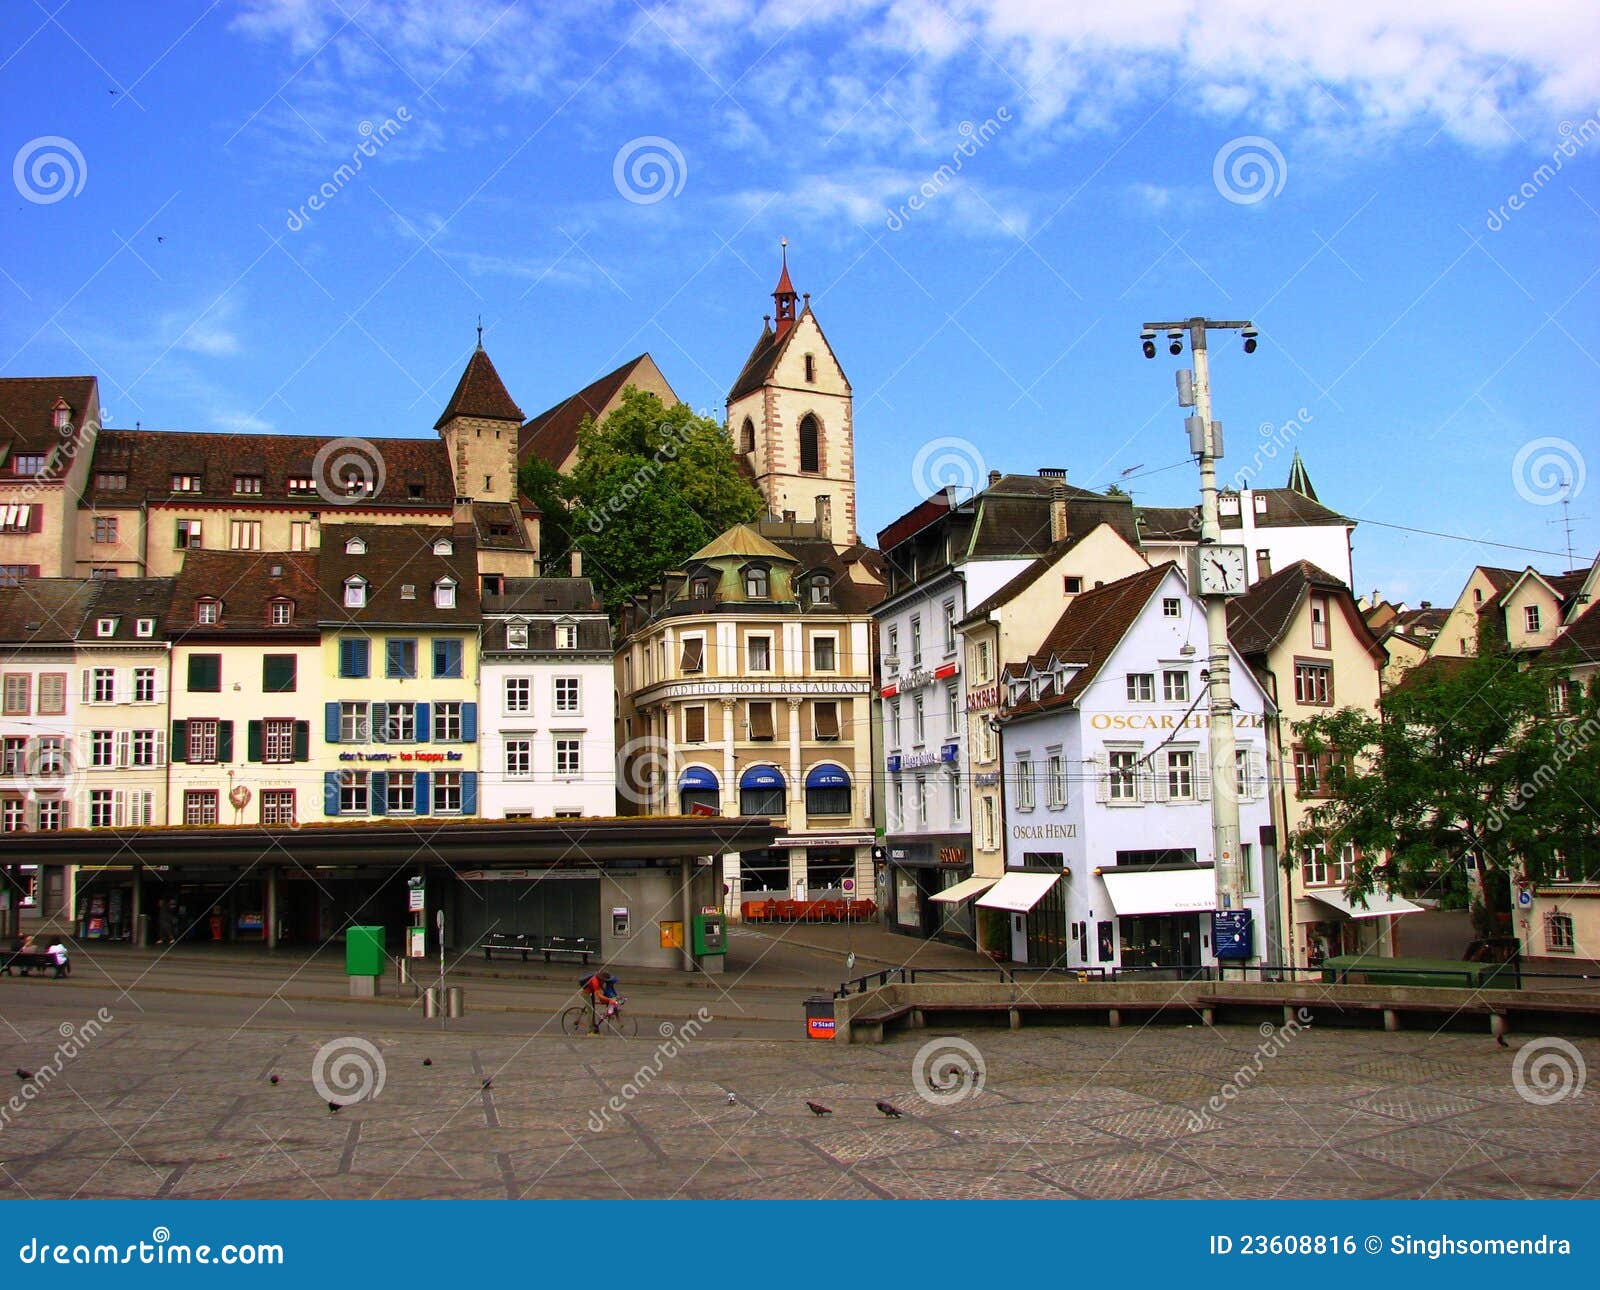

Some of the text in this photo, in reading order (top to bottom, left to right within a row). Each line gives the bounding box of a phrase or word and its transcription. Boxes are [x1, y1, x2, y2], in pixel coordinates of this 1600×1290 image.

[731, 683, 773, 694] HOTEL
[780, 682, 868, 694] RESTAURANT
[1090, 713, 1265, 730] OSCAR HZI
[400, 751, 413, 761] be
[415, 750, 444, 763] happy
[1013, 823, 1077, 840] OSCAR HENZI
